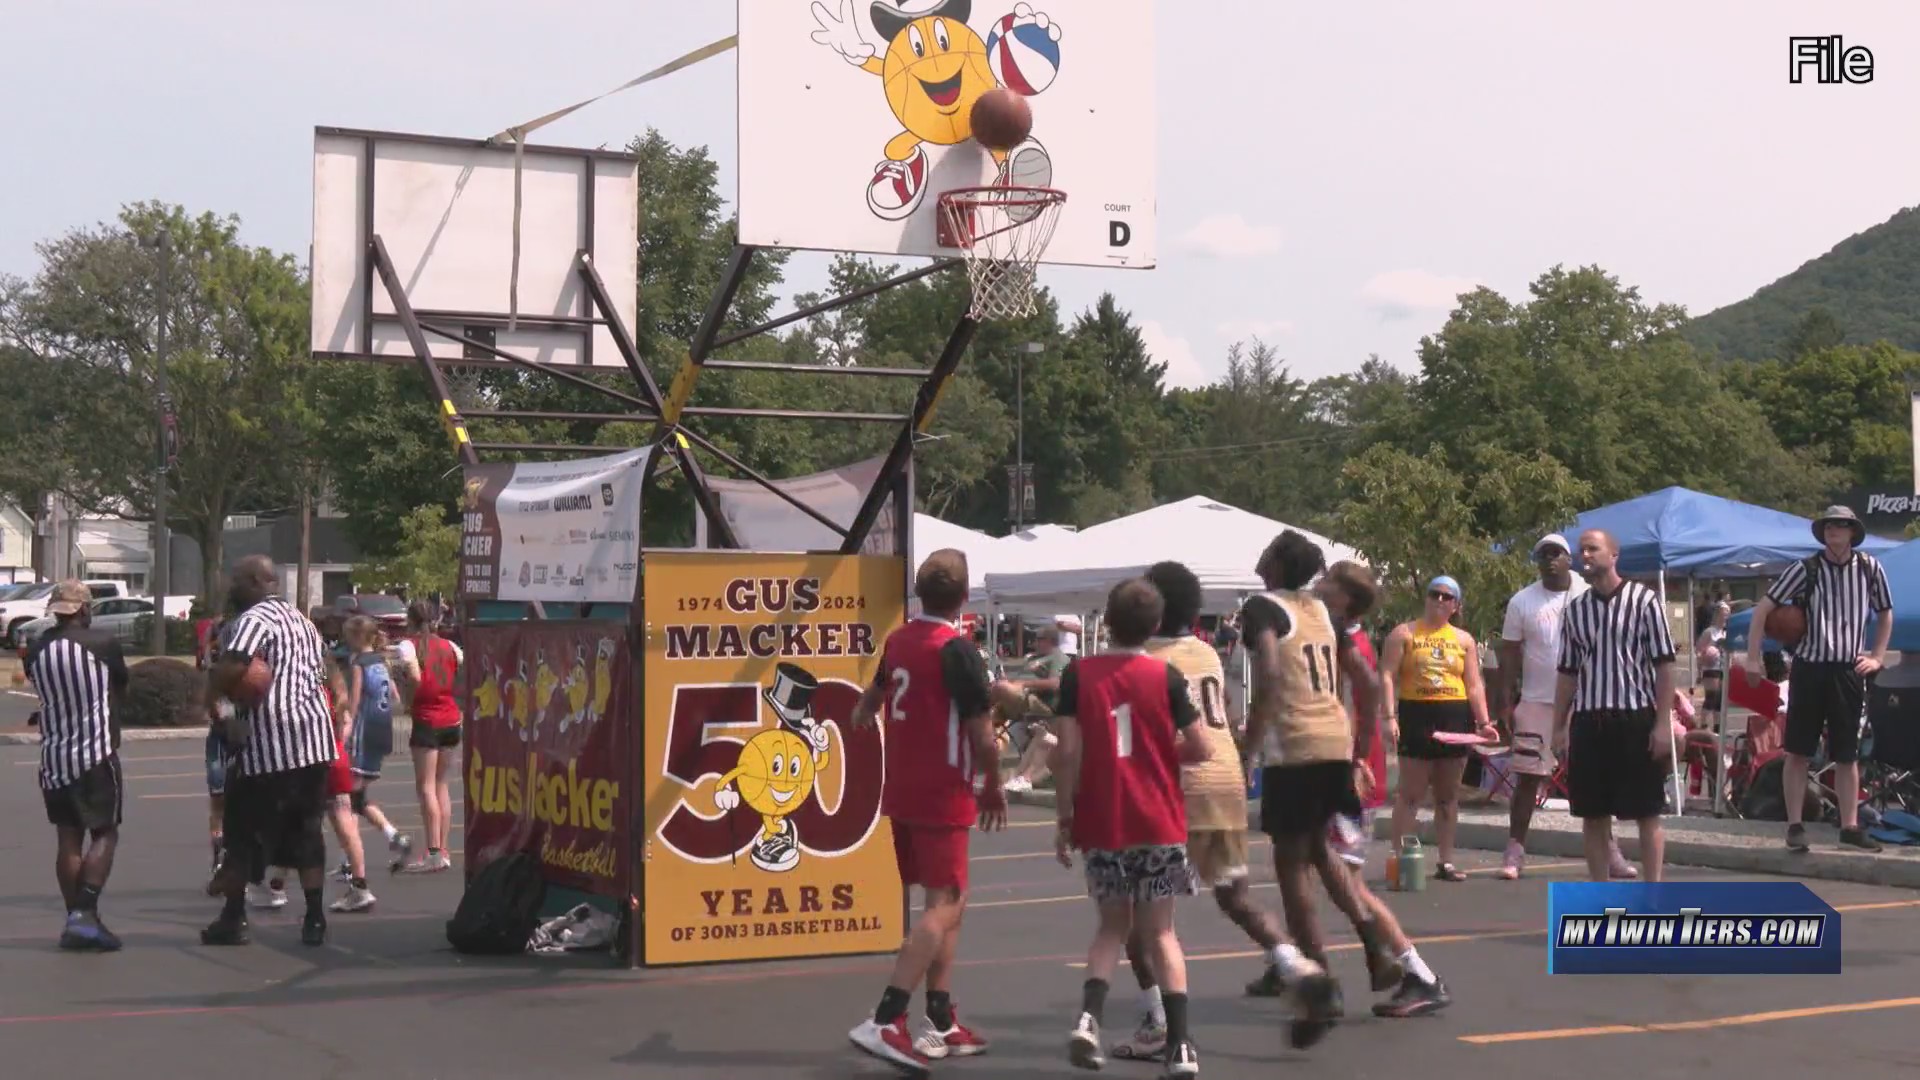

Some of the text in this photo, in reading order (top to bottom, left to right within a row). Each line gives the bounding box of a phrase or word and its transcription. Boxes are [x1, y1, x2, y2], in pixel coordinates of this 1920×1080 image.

[1104, 203, 1131, 212] COURT
[1109, 220, 1131, 247] D
[554, 495, 592, 513] WILLIAMS
[1866, 493, 1909, 514] Pizza
[677, 576, 866, 614] 1974 GUS 2024
[665, 622, 878, 660] MACKER
[1301, 642, 1335, 694] 11
[890, 666, 910, 721] 2
[1109, 703, 1132, 757] 1
[656, 677, 886, 865] 50
[700, 884, 855, 917] YEARS
[670, 927, 696, 941] OF
[753, 916, 882, 937] BASKETBALL
